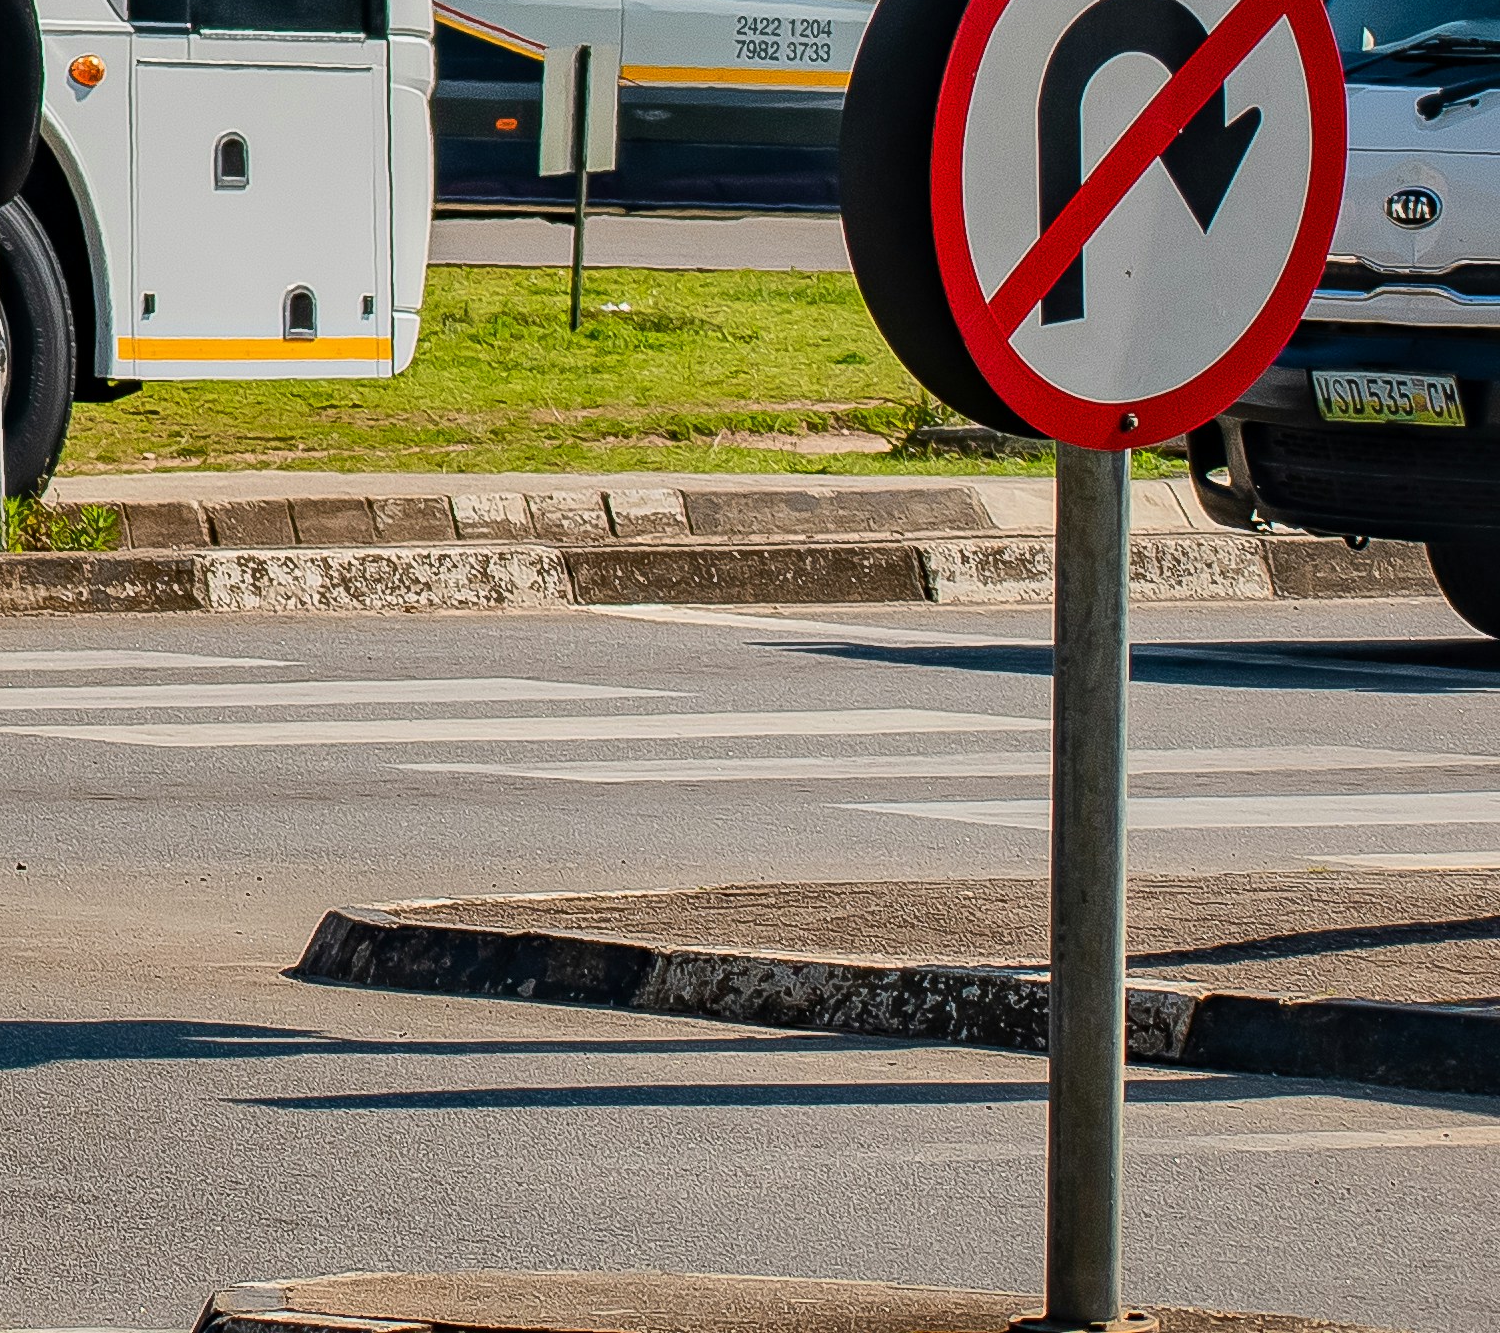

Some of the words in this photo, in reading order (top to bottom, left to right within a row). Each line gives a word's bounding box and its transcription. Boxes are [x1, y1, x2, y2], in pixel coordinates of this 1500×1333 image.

[736, 15, 782, 37] 2422
[789, 18, 833, 39] 1204
[734, 39, 780, 62] 7982
[786, 41, 831, 63] 3733
[1391, 195, 1432, 219] KIA
[1316, 377, 1366, 415] VSD
[1366, 378, 1414, 416] 535
[1425, 382, 1463, 420] CM
